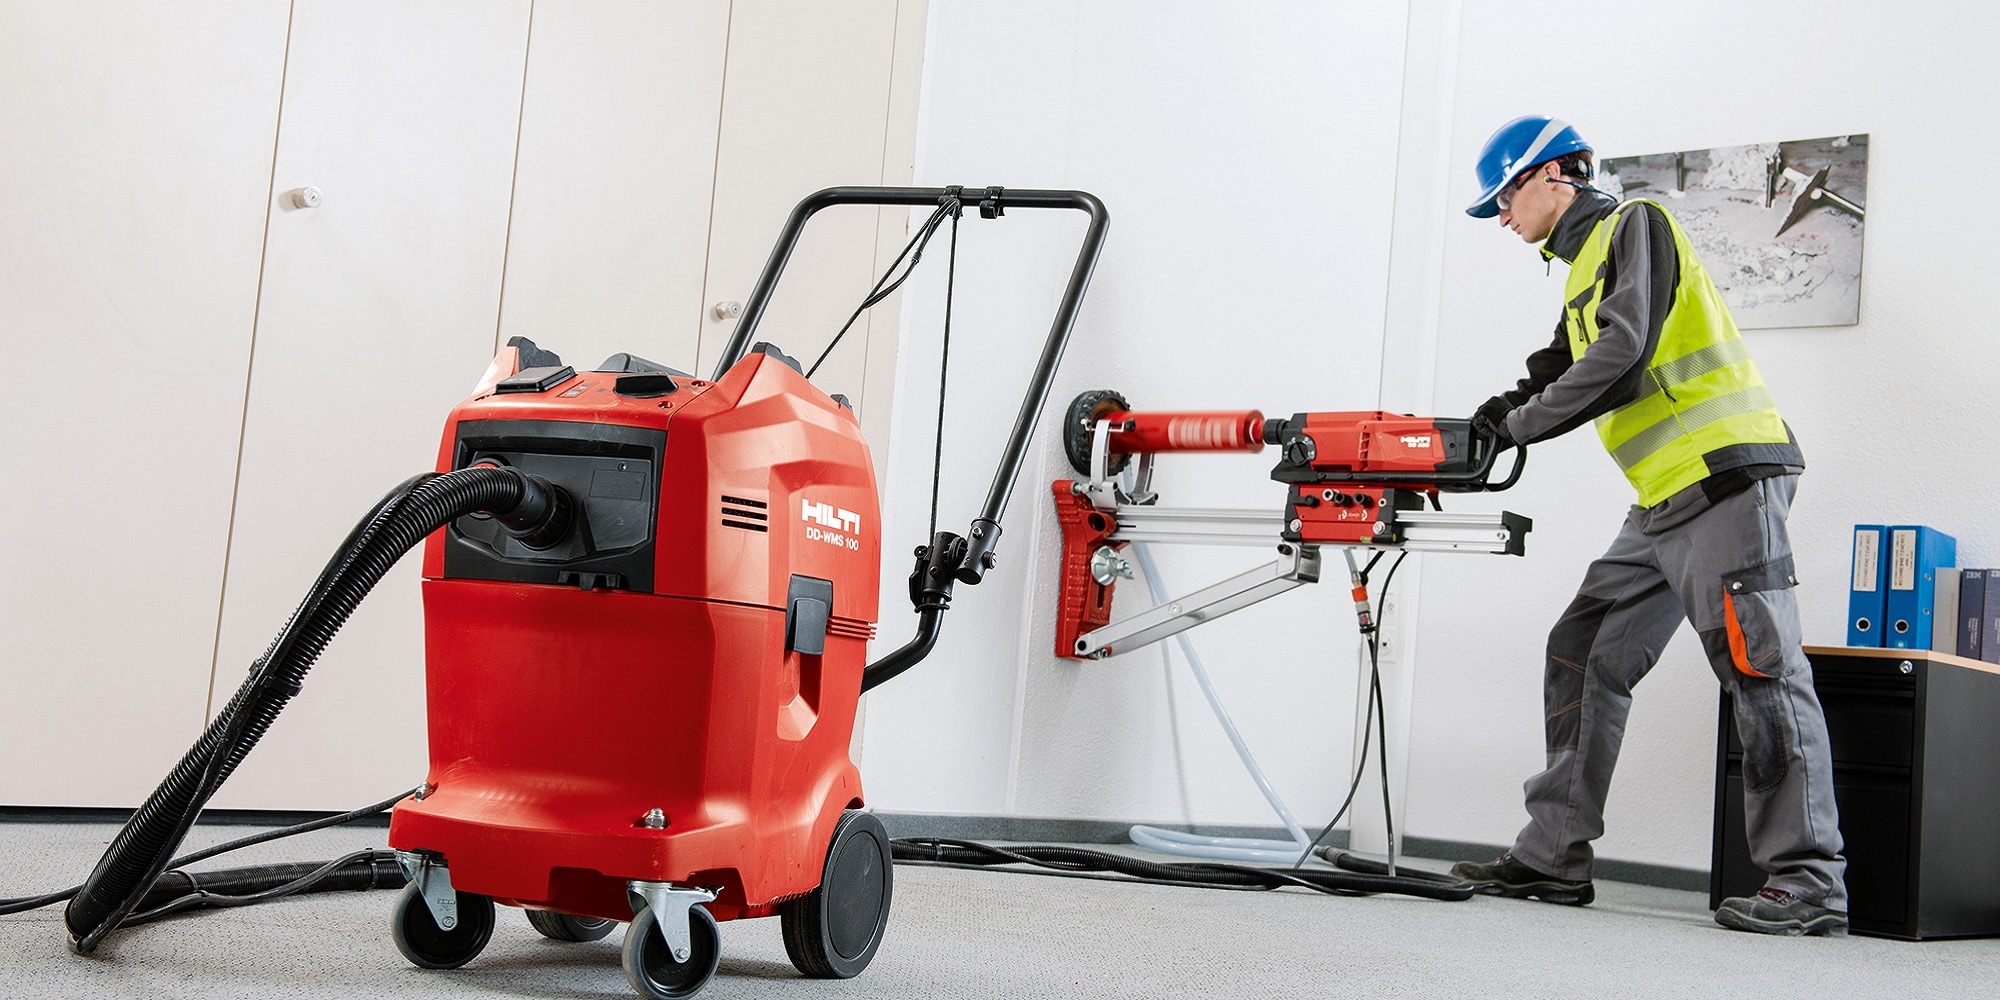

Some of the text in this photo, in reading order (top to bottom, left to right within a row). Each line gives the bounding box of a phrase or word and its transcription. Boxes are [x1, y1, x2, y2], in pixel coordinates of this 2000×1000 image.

[802, 498, 861, 535] HILTI
[806, 526, 859, 551] DD-WMS 100
[1966, 571, 1982, 579] IBM
[1991, 570, 2000, 578] IB
